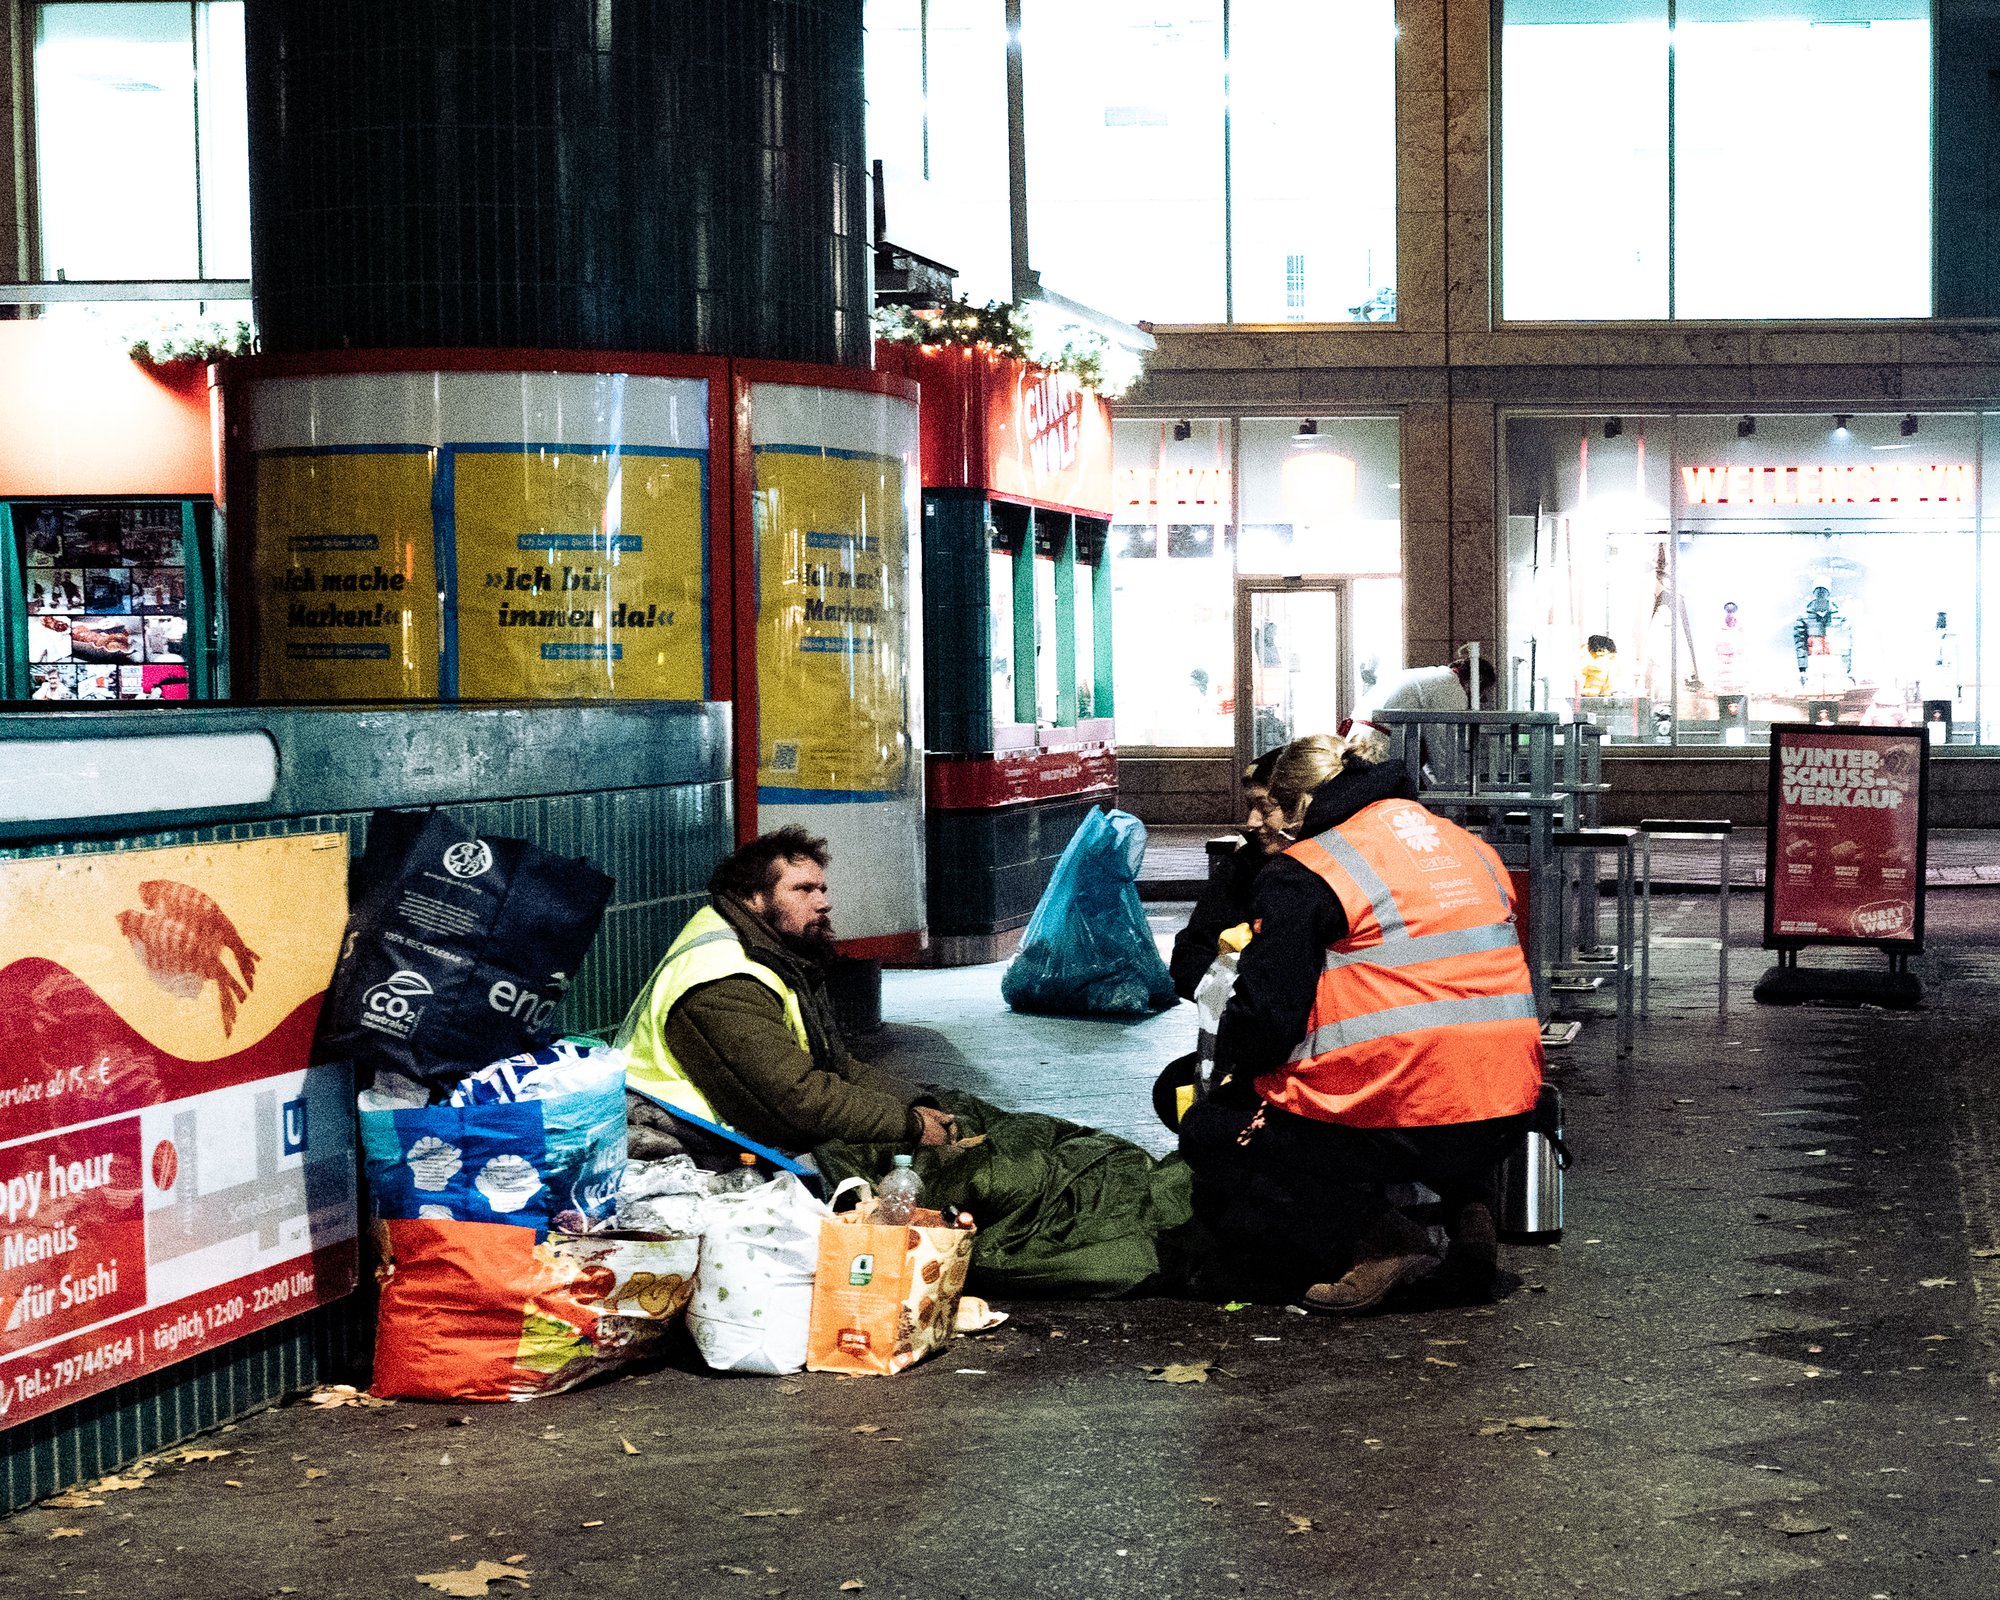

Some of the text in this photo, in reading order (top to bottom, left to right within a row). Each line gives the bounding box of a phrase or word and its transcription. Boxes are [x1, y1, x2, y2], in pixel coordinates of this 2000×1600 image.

[322, 567, 405, 592] mache
[484, 567, 550, 592] »Ich
[612, 604, 675, 628] da!«
[1783, 767, 1888, 788] SCHUSS-
[1783, 786, 1902, 809] VERKAUF
[1857, 906, 1905, 924] CURRY
[1862, 917, 1903, 935] WOLF
[363, 1011, 410, 1034] neutrales
[49, 1152, 114, 1200] hour
[3, 1219, 79, 1271] Menüs
[20, 1258, 118, 1323] für Sushi
[14, 1368, 51, 1403] Tel.:
[52, 1336, 134, 1389] 79744564
[205, 1296, 244, 1329] 12:00
[252, 1280, 289, 1313] 22:00
[291, 1271, 315, 1298] Uhr
